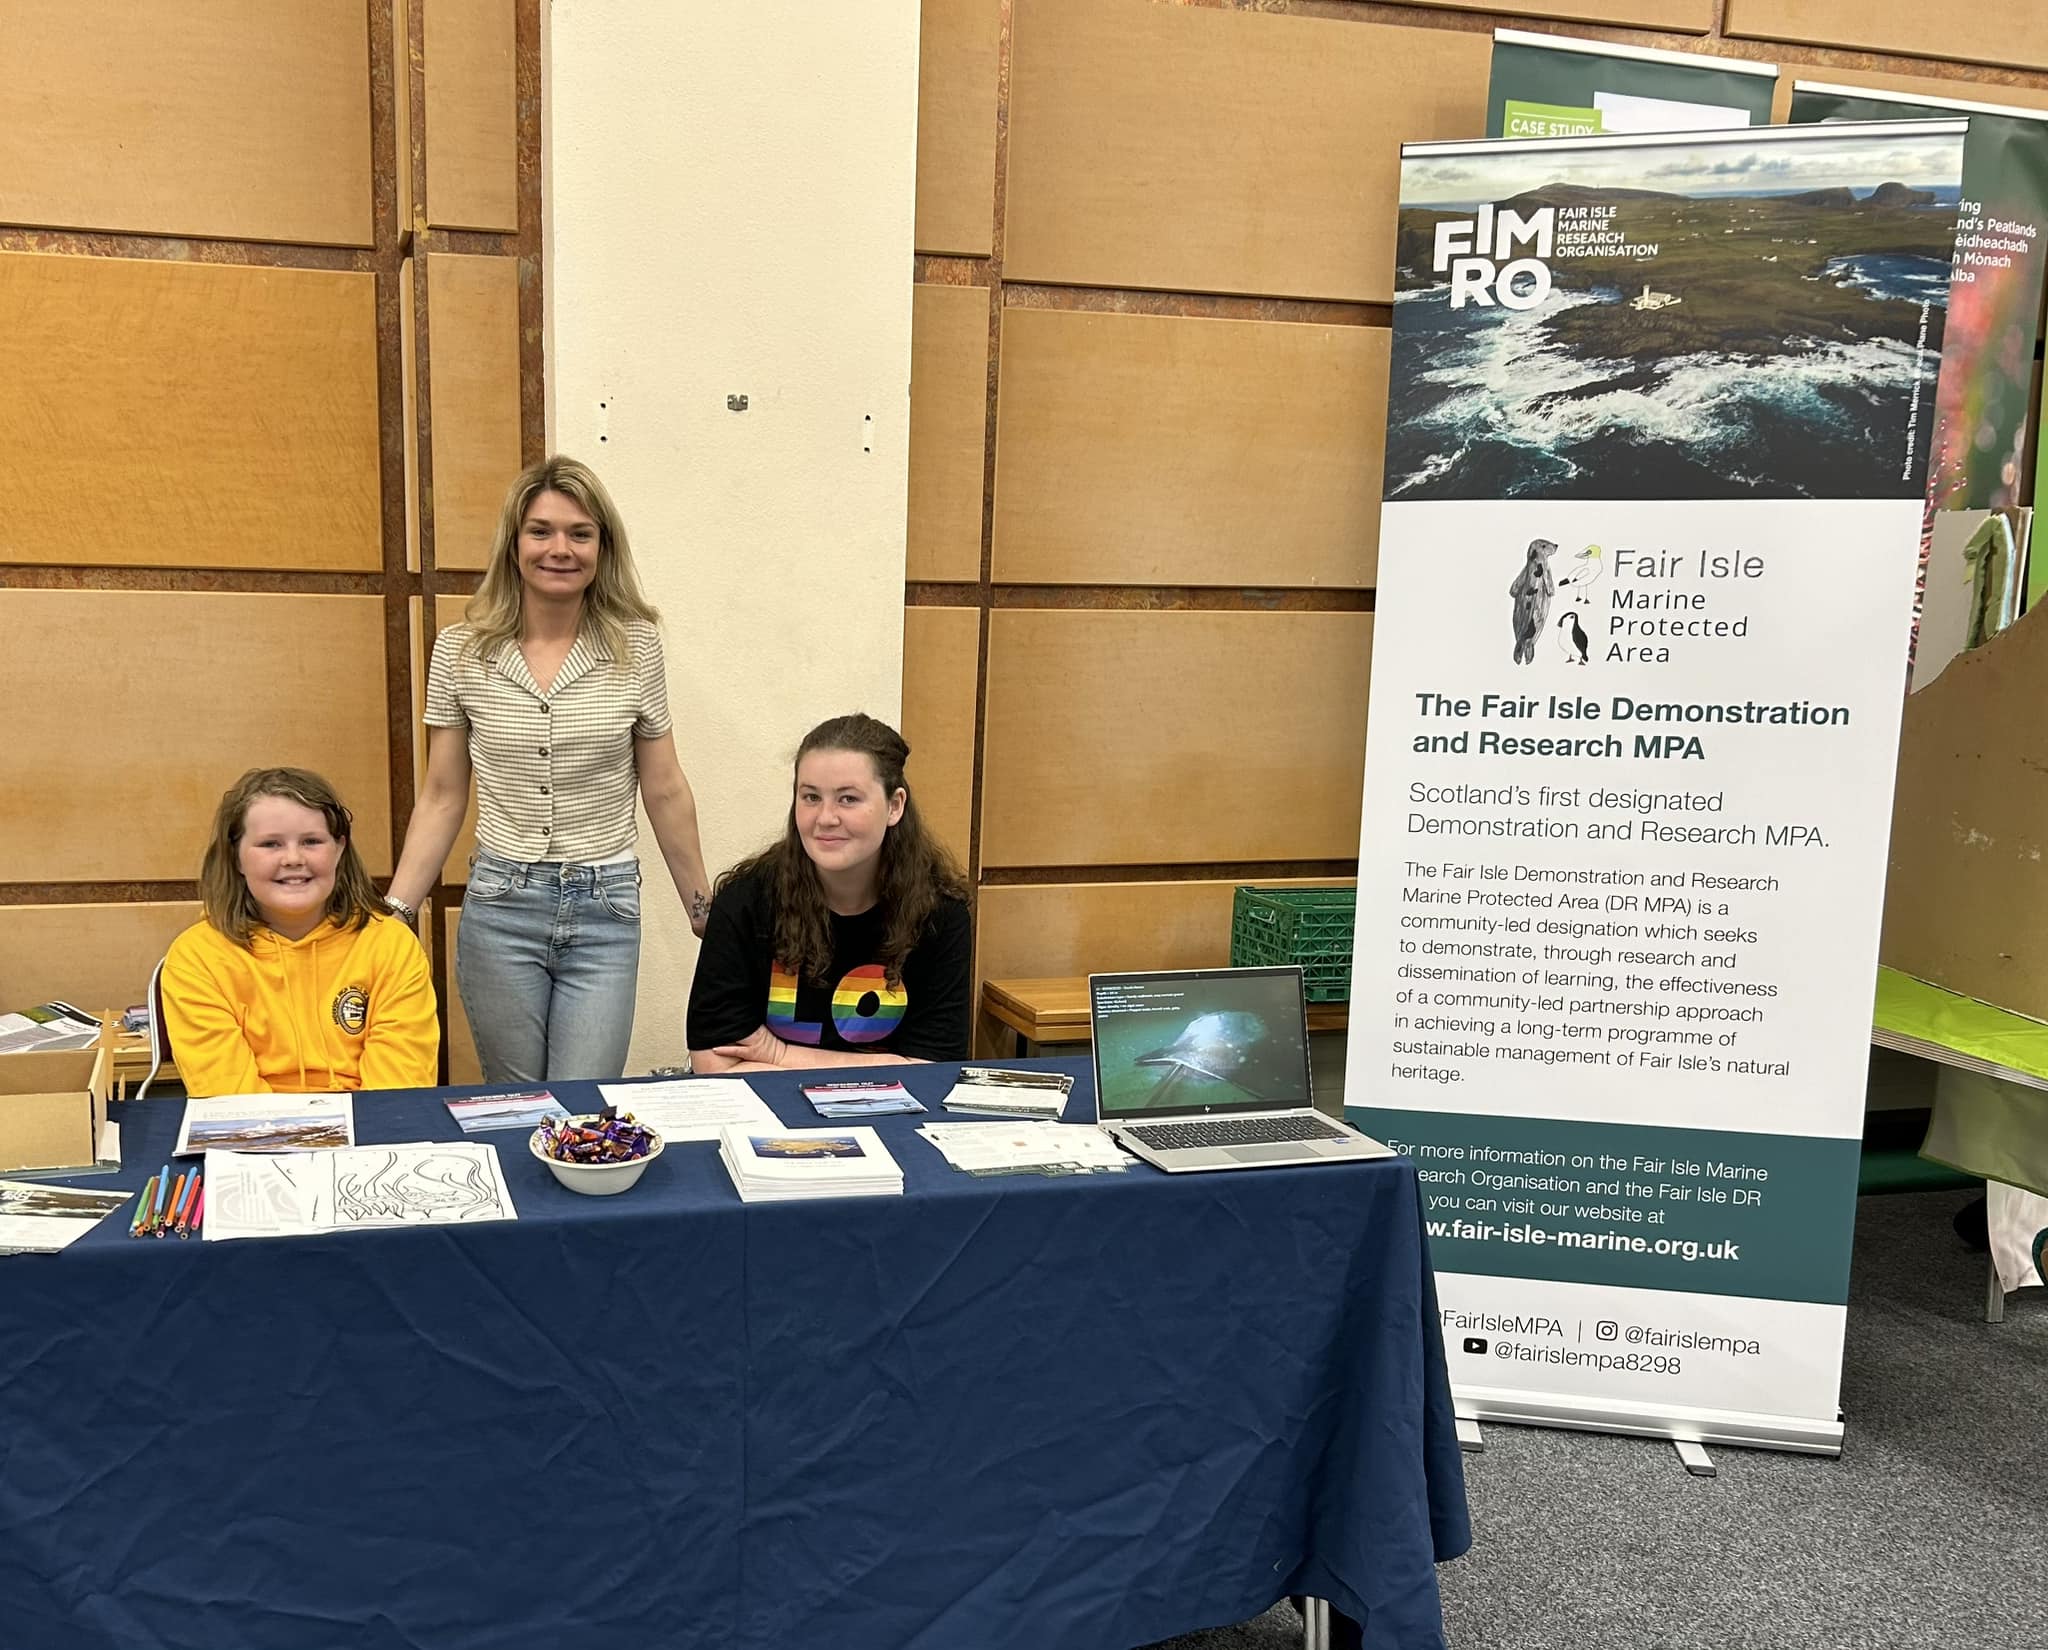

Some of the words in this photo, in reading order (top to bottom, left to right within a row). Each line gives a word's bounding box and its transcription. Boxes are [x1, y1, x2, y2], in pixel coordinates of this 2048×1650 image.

[1511, 118, 1545, 135] CASE
[1549, 122, 1594, 137] STUDY
[1557, 219, 1609, 231] MARINE
[1558, 207, 1587, 219] FAIR
[1590, 206, 1616, 218] ISLE
[1556, 232, 1624, 244] RESEARCH
[1987, 218, 2037, 238] Peatlands
[1555, 243, 1658, 257] ORGANISATION
[1954, 234, 2029, 253] èidheachadh
[1964, 251, 2012, 268] Mònach
[1919, 299, 1930, 324] Photo
[1916, 324, 1928, 348] Plane
[1907, 412, 1918, 428] Tim
[1906, 429, 1916, 455] credit:
[1902, 456, 1913, 481] Photo
[1614, 549, 1683, 578] Fair
[1699, 549, 1763, 578] Isle
[1612, 589, 1705, 609] Marine
[1609, 615, 1747, 636] Protected
[1605, 642, 1669, 662] Area
[1415, 693, 1471, 717] The
[1481, 694, 1539, 718] Fair
[1548, 695, 1600, 720] Isle
[1611, 696, 1849, 725] Demonstration
[1412, 730, 1468, 753] and
[1479, 731, 1622, 757] Research
[1633, 734, 1704, 759] MPA
[1409, 782, 1529, 805] Scotland's
[1538, 785, 1580, 806] first
[1588, 787, 1722, 814] designated
[1408, 813, 1578, 838] Demonstration
[1586, 820, 1632, 840] and
[1641, 820, 1755, 844] Research
[1765, 824, 1828, 847] MPA.
[1404, 861, 1436, 877] The
[1442, 863, 1474, 878] Fair
[1480, 864, 1508, 880] Isle
[1514, 865, 1644, 885] Demonstration
[1650, 871, 1685, 887] and
[1691, 872, 1778, 891] Research
[1402, 887, 1461, 904] Marine
[1467, 889, 1552, 907] Protected
[1557, 893, 1598, 909] Area
[1605, 895, 1637, 913] (DR
[1644, 896, 1691, 917] MPA)
[1697, 902, 1711, 914] is
[1717, 903, 1728, 915] a
[1400, 915, 1530, 934] community-led
[1536, 919, 1638, 938] designation
[1644, 923, 1697, 940] which
[1703, 927, 1757, 943] seeks
[1399, 938, 1416, 953] to
[1421, 939, 1536, 960] demonstrate,
[1543, 944, 1611, 965] through
[1617, 950, 1694, 965] research
[1700, 953, 1736, 968] and
[1397, 963, 1515, 982] dissemination
[1522, 969, 1539, 984] of
[1544, 969, 1617, 991] learning,
[1625, 974, 1653, 990] the
[1659, 976, 1777, 996] effectiveness
[1396, 988, 1413, 1003] of
[1417, 992, 1428, 1004] a
[1433, 993, 1563, 1012] community-led
[1569, 999, 1669, 1020] partnership
[1675, 1006, 1762, 1022] approach
[1394, 1012, 1409, 1029] in
[1414, 1015, 1494, 1036] achieving
[1500, 1022, 1511, 1033] a
[1517, 1019, 1601, 1039] long-term
[1607, 1027, 1712, 1045] programme
[1718, 1031, 1736, 1046] of
[1392, 1040, 1489, 1057] sustainable
[1495, 1047, 1610, 1065] management
[1616, 1051, 1634, 1066] of
[1639, 1051, 1672, 1068] Fair
[1678, 1053, 1720, 1071] Isle's
[1727, 1059, 1789, 1075] natural
[1391, 1061, 1465, 1084] heritage.
[1387, 1139, 1415, 1157] For
[1420, 1145, 1464, 1159] more
[1469, 1144, 1565, 1166] information
[1571, 1155, 1593, 1168] on
[1599, 1154, 1627, 1170] the
[1632, 1156, 1666, 1173] Fair
[1671, 1159, 1700, 1176] Isle
[1706, 1161, 1768, 1181] Marine
[1418, 1168, 1465, 1184] earch
[1471, 1169, 1579, 1192] Organisation
[1585, 1180, 1619, 1195] and
[1624, 1181, 1653, 1197] the
[1658, 1183, 1692, 1200] Fair
[1697, 1186, 1726, 1203] Isle
[1732, 1188, 1761, 1206] DR
[1428, 1195, 1459, 1209] you
[1465, 1197, 1496, 1211] can
[1502, 1197, 1534, 1214] visit
[1540, 1203, 1569, 1216] our
[1574, 1204, 1642, 1222] website
[1647, 1209, 1664, 1224] at
[1425, 1218, 1739, 1261] w.fair-isle-marine.org.uk
[1440, 1309, 1563, 1336] FairIsleMPA
[1624, 1325, 1760, 1356] @fairislempa
[1494, 1341, 1680, 1374] @fairislempa8298
